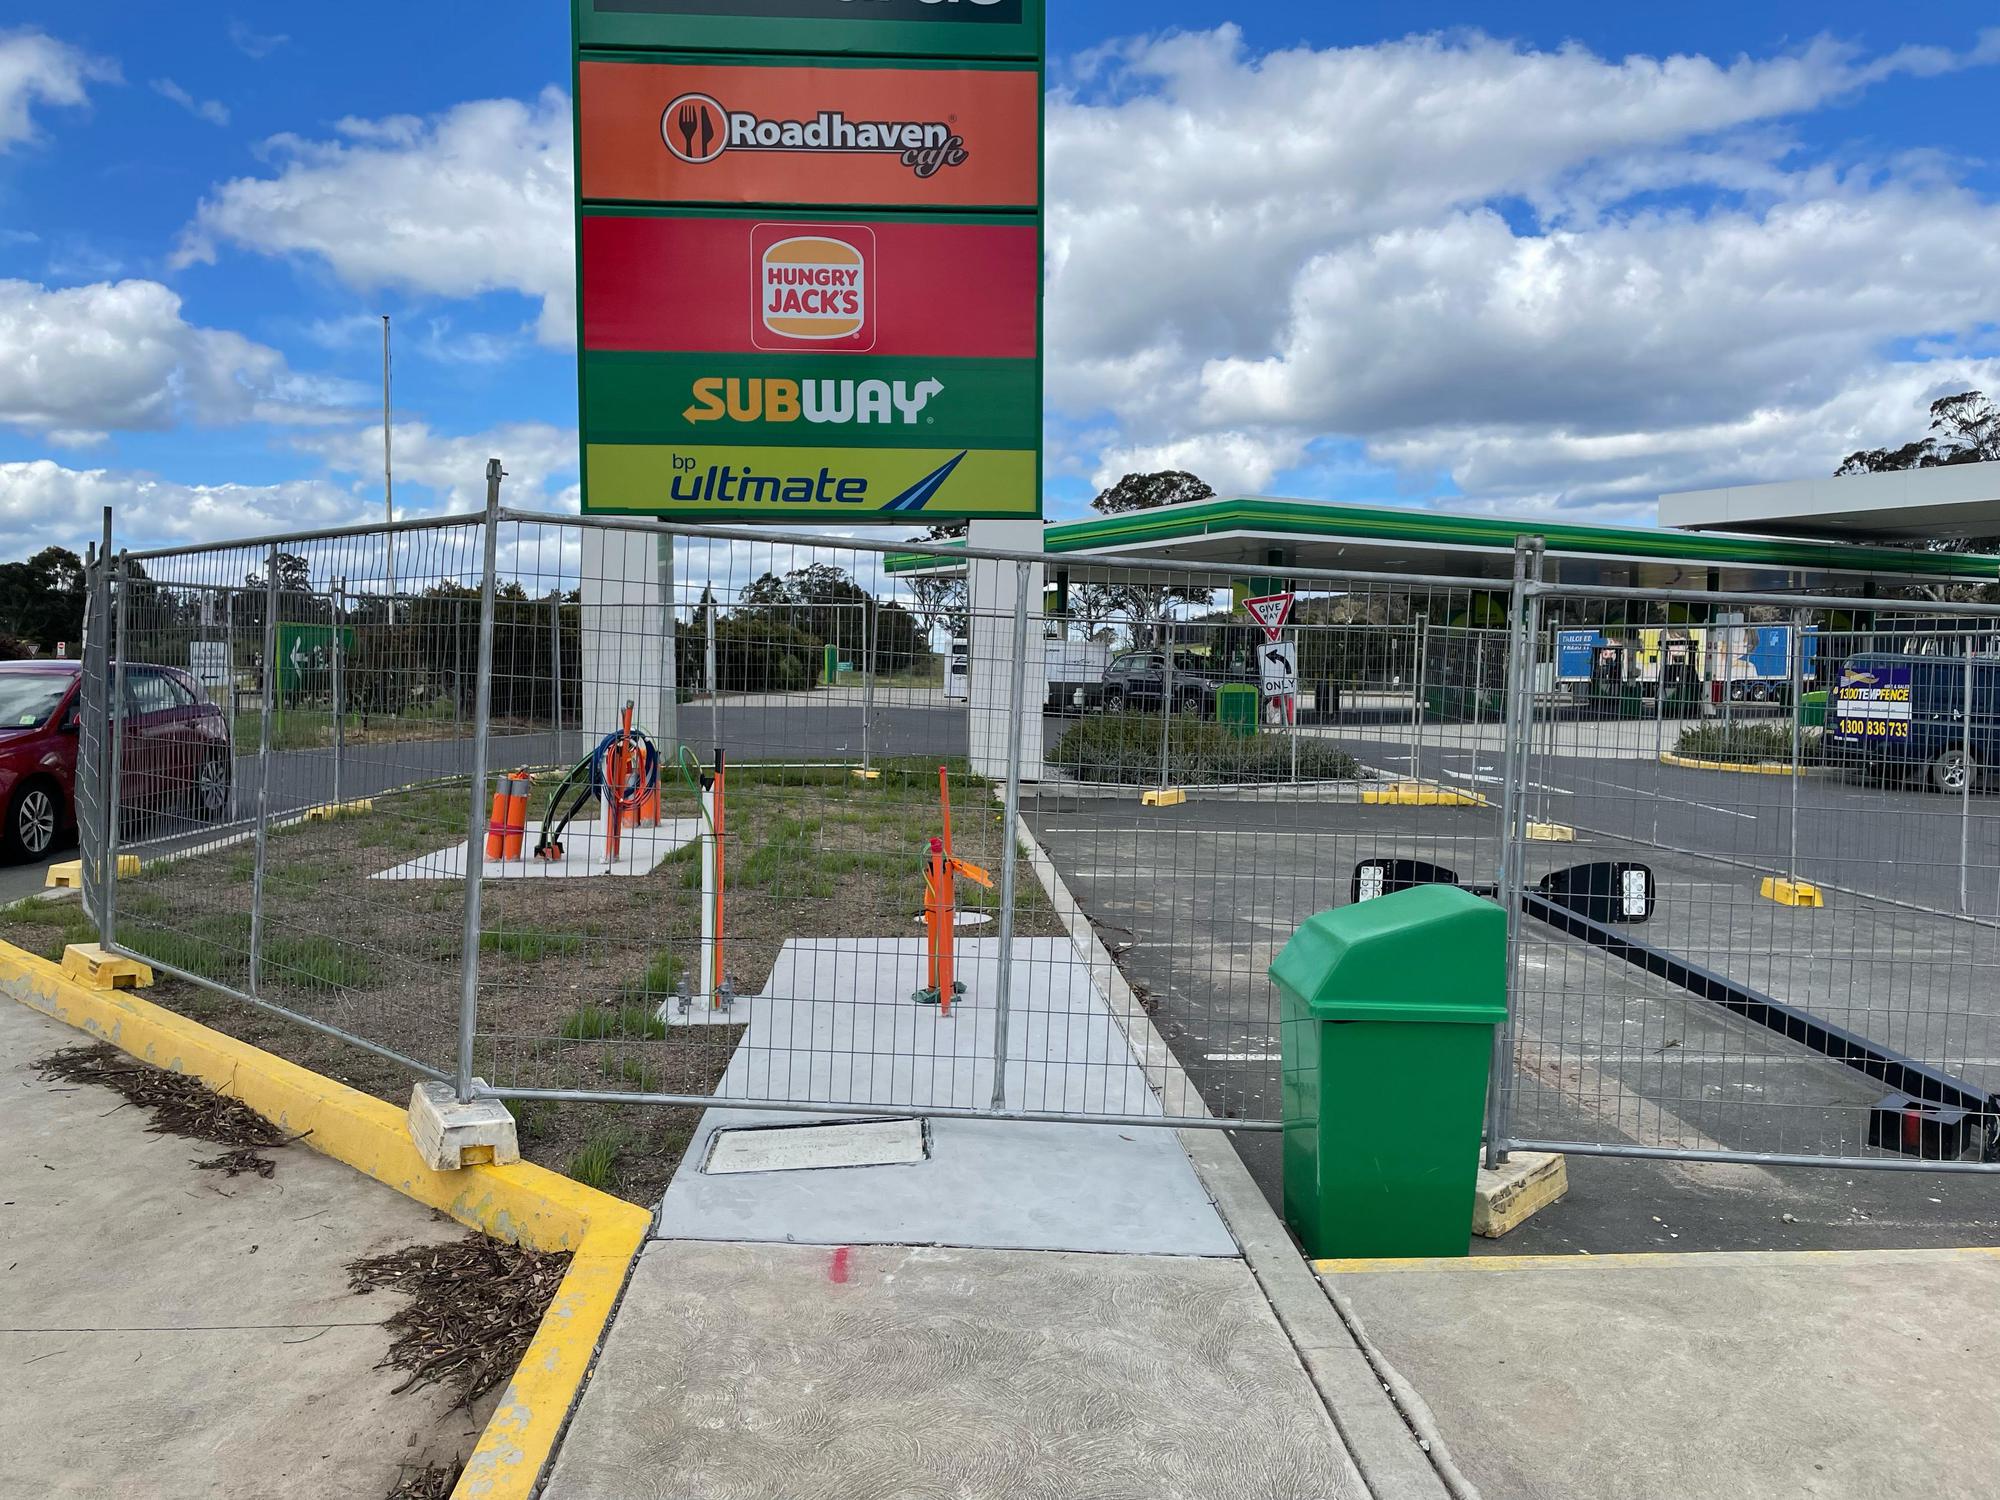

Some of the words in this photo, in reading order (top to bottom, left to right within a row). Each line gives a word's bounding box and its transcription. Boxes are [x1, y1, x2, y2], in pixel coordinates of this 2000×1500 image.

[730, 111, 949, 149] Roadhaven
[901, 132, 967, 177] cafe
[768, 267, 859, 287] HUNGRY
[768, 289, 859, 315] JACK'S
[682, 376, 945, 425] SUBWAY
[672, 453, 696, 474] bp
[670, 465, 868, 504] ultimate
[1258, 602, 1281, 613] GIVE
[1265, 680, 1295, 691] ONLY
[1840, 720, 1864, 735] 1300
[1867, 721, 1886, 736] 836
[1888, 722, 1908, 737] 733
